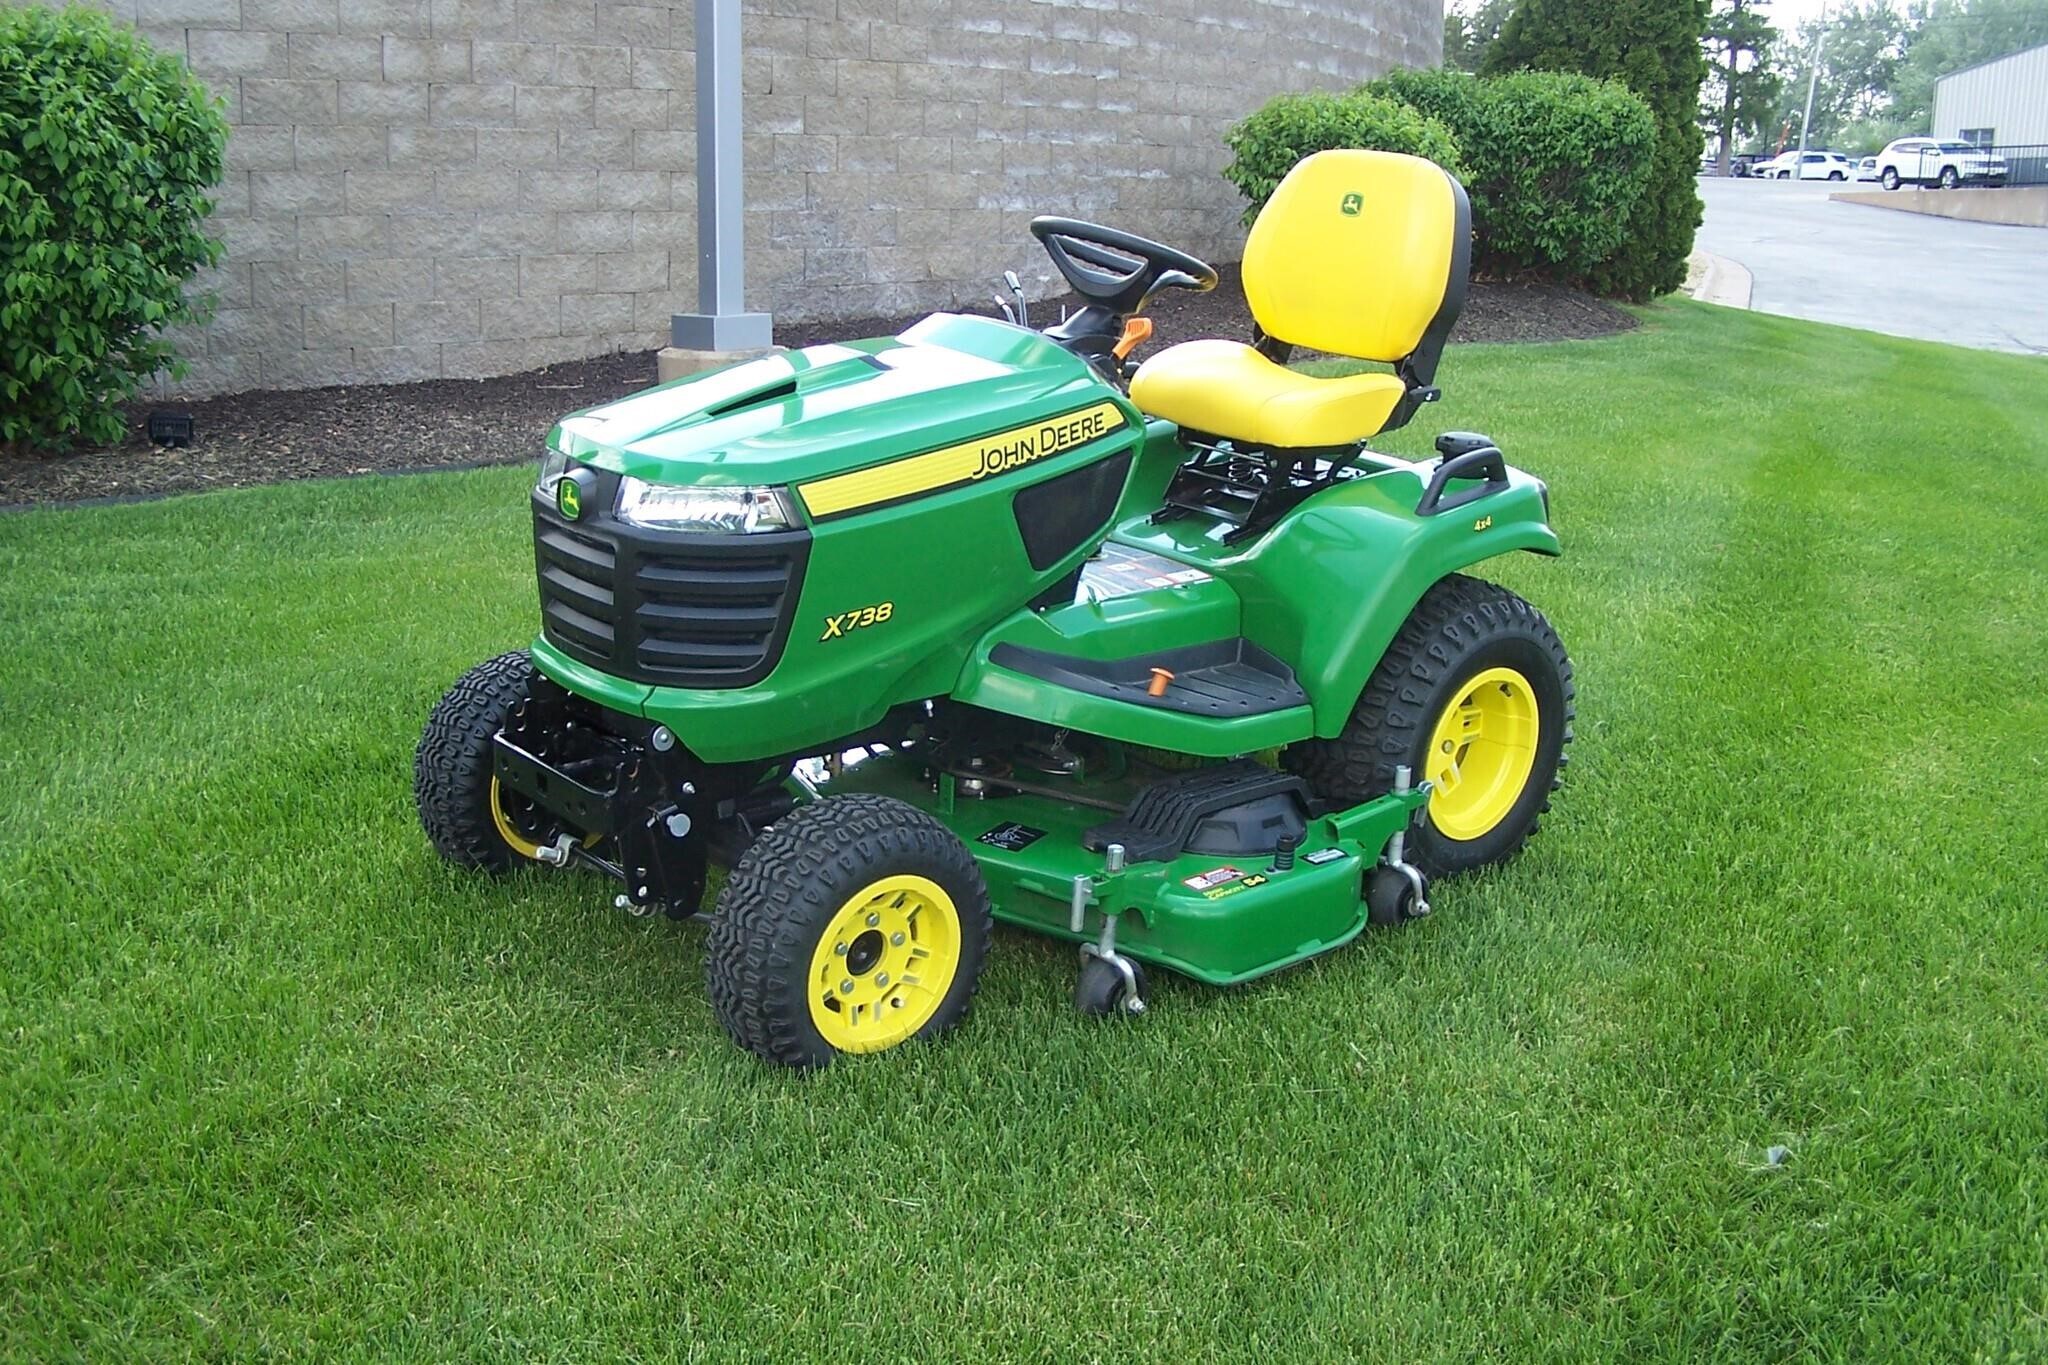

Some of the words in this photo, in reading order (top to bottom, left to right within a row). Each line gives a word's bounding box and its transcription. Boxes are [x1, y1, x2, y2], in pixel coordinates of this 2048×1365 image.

[972, 436, 1035, 476] JOHN
[1040, 411, 1105, 453] DEERE
[1474, 515, 1491, 531] 4x4
[820, 601, 894, 641] X738
[1242, 875, 1266, 887] 54
